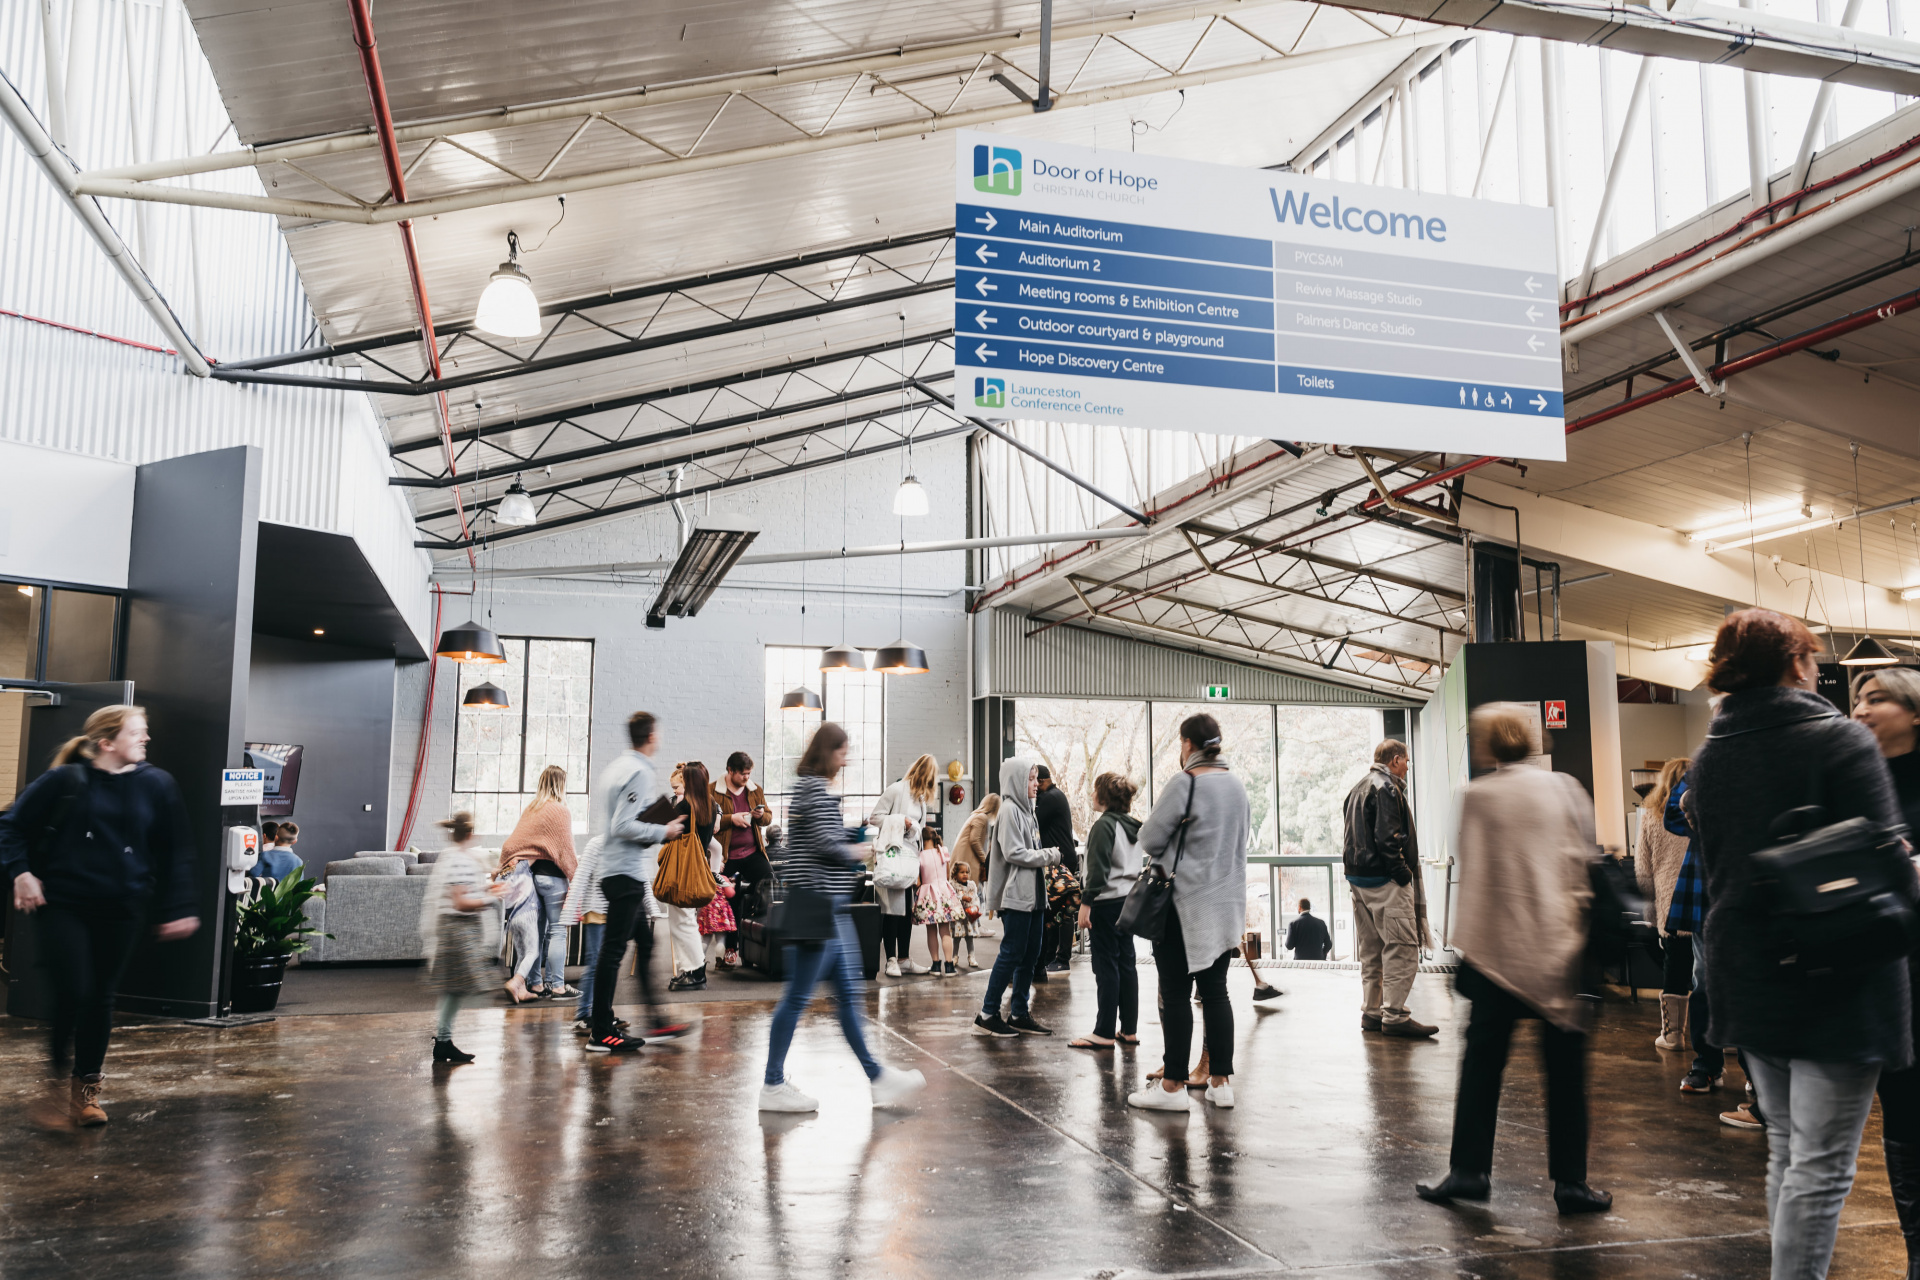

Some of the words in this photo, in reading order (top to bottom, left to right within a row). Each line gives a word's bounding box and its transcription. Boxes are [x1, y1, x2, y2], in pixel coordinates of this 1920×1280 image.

[1033, 159, 1079, 180] Door
[1085, 167, 1105, 183] of
[1109, 169, 1158, 192] Hope
[1033, 182, 1094, 200] CHRISTIAN
[1097, 190, 1145, 206] CHURCH
[1269, 187, 1447, 243] Welcome
[1019, 218, 1050, 235] Main
[1053, 223, 1123, 243] Auditorium
[1018, 251, 1089, 271] Auditorium
[1093, 259, 1101, 272] 2
[1295, 251, 1343, 268] PYCSAM
[1019, 284, 1071, 304] Meeting
[1074, 292, 1115, 307] rooms
[1119, 294, 1129, 308] &
[1133, 296, 1194, 315] Exhibition
[1197, 302, 1239, 318] Centre
[1295, 282, 1332, 297] Revive
[1335, 286, 1384, 304] Massage
[1387, 291, 1422, 307] Studio
[1018, 316, 1075, 335] Outdoor
[1077, 324, 1139, 341] courtyard
[1142, 327, 1152, 341] &
[1155, 331, 1224, 349] playground
[1343, 317, 1378, 332] Dance
[1380, 321, 1415, 336] Studio
[1018, 349, 1054, 368] Hope
[1058, 353, 1119, 373] Discovery
[1122, 359, 1164, 375] Centre
[1011, 383, 1081, 399] Launceston
[1297, 374, 1335, 390] Toilets
[1011, 396, 1081, 413] Conference
[1084, 402, 1124, 416] Centre
[229, 772, 259, 780] NOTICE
